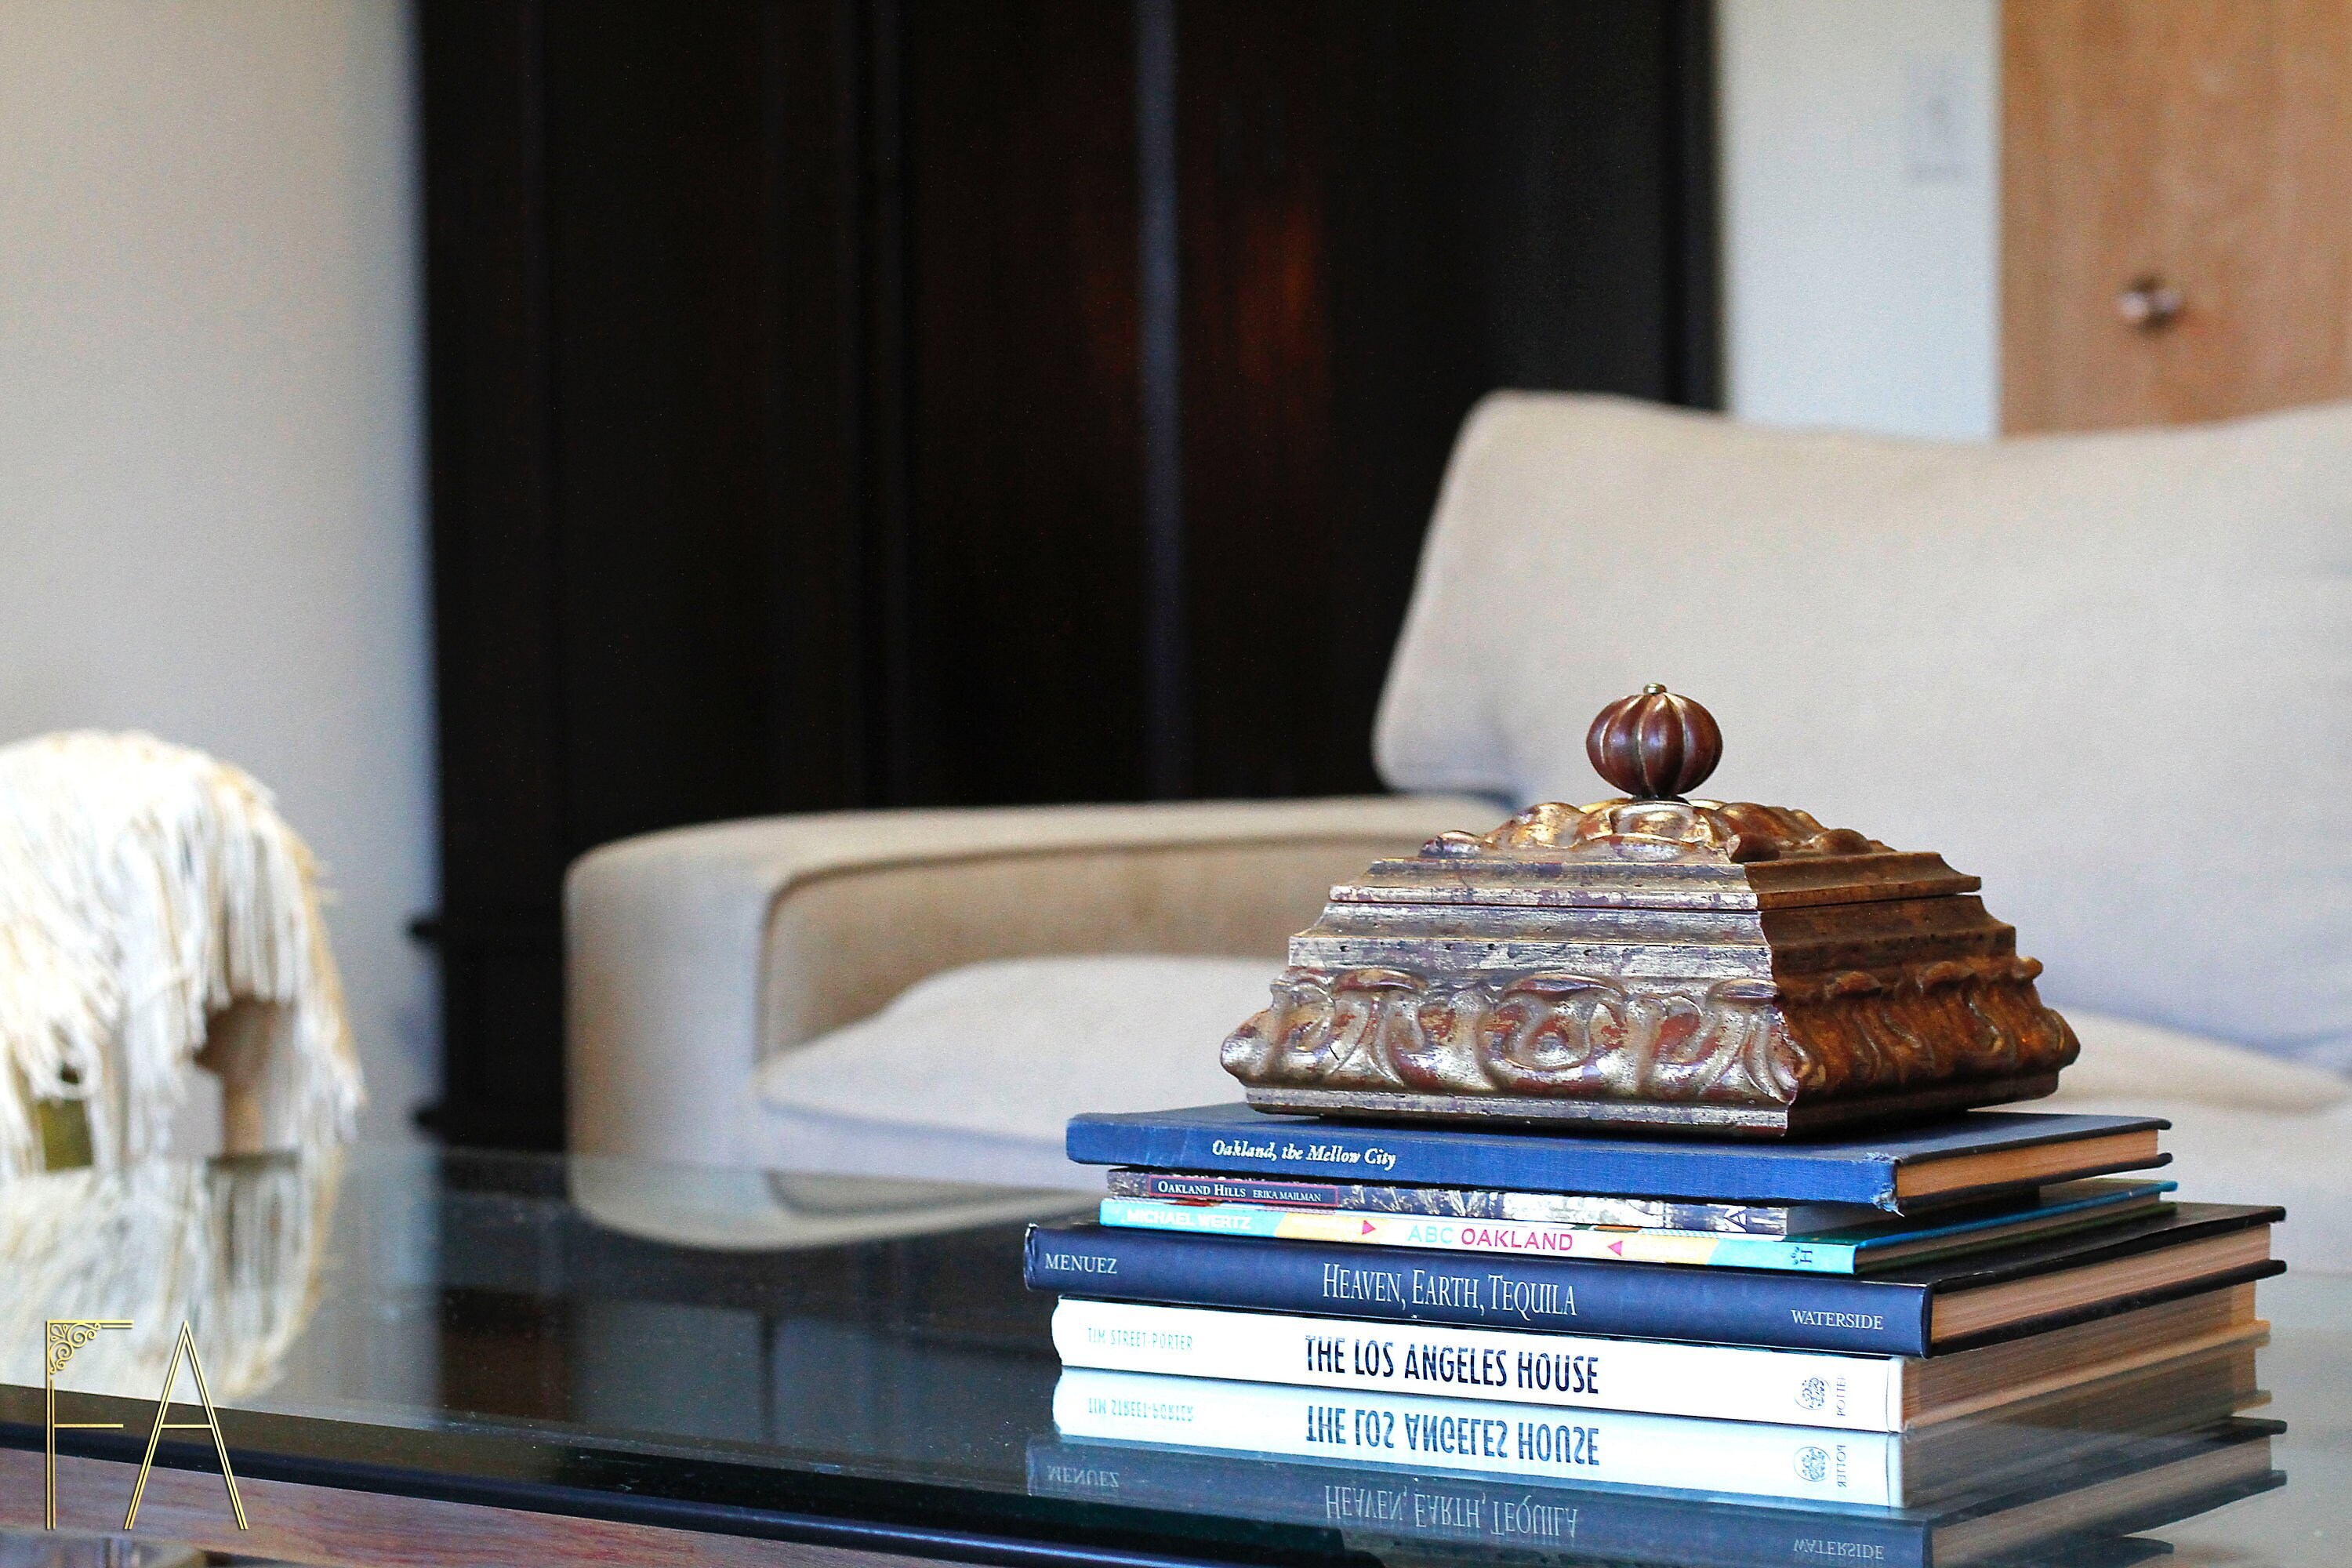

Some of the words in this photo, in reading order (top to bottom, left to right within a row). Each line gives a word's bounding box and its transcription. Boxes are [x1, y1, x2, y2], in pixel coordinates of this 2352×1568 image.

[1212, 1139, 1277, 1161] Oakland,
[1281, 1143, 1303, 1160] the
[1306, 1145, 1361, 1163] Mellow
[1364, 1148, 1396, 1171] City
[1158, 1181, 1211, 1196] OAKLAND
[1214, 1184, 1246, 1198] HILLS
[1253, 1189, 1277, 1200] ERIKA
[1279, 1191, 1321, 1202] MAILMAN
[1126, 1208, 1194, 1226] MICHAEL
[1197, 1215, 1251, 1230] WERTZ
[1407, 1225, 1453, 1244] ABC
[1461, 1228, 1573, 1251] OAKLAND
[1044, 1253, 1117, 1274] MENUEZ
[1323, 1263, 1406, 1311] HEAVEN,
[1411, 1269, 1485, 1316] EARTH,
[1488, 1274, 1577, 1321] TEQUILA
[1791, 1309, 1884, 1330] WATERSIDE
[1088, 1327, 1105, 1343] TIM
[1305, 1334, 1345, 1374] THE
[1354, 1339, 1394, 1377] LOS
[1404, 1344, 1508, 1387] ANGELES
[1518, 1352, 1599, 1394] HOUSE
